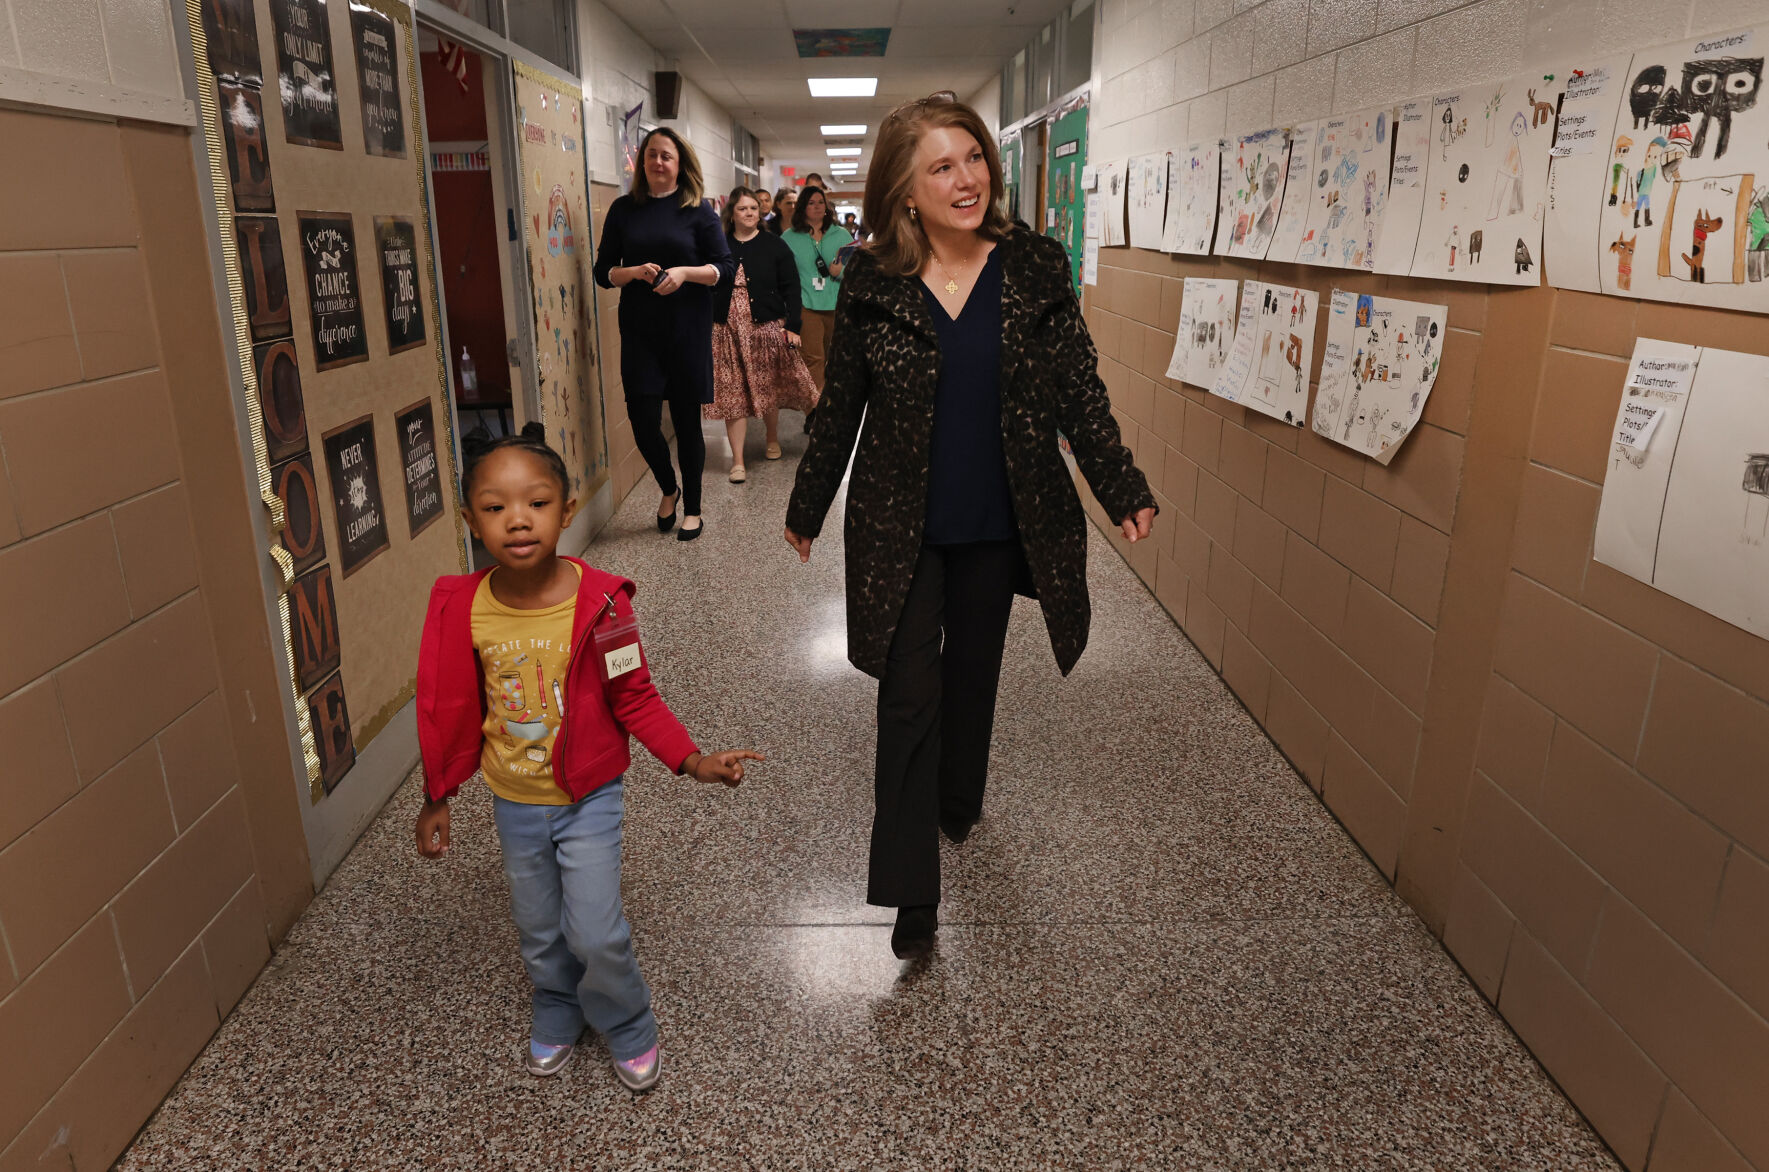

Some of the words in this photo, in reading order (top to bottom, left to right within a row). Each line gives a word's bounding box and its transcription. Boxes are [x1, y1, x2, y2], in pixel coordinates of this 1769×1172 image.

[283, 31, 302, 59] ONLY
[303, 39, 323, 65] LIMIT
[306, 228, 350, 254] Everyone
[315, 271, 350, 297] CHANCE
[398, 268, 414, 302] BIG
[316, 300, 325, 312] to
[326, 295, 348, 312] make
[349, 297, 354, 309] a
[392, 292, 410, 335] days
[318, 316, 357, 354] difference
[407, 418, 423, 445] your
[340, 442, 363, 470] NEVER
[406, 452, 435, 484] DETERMINES
[346, 509, 376, 543] LEARNING
[529, 638, 551, 650] THE
[611, 656, 634, 672] Kylar
